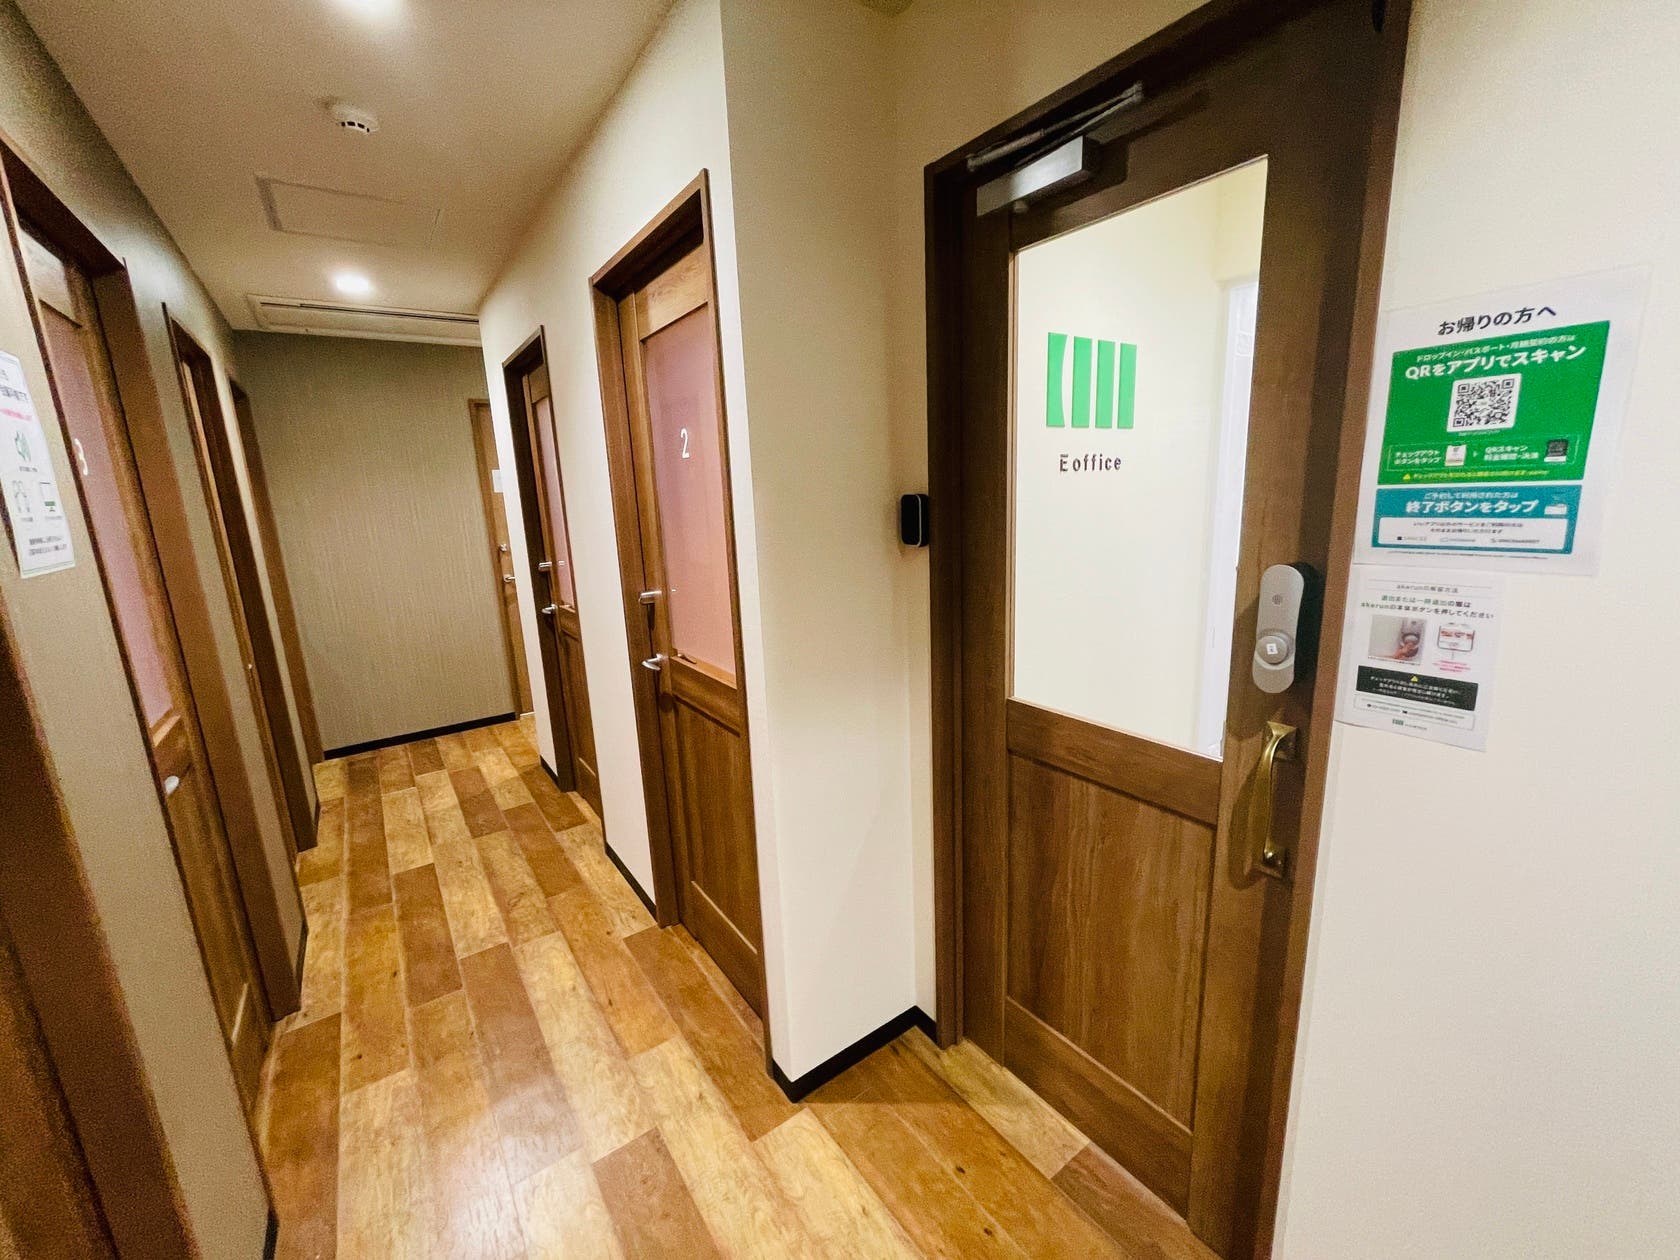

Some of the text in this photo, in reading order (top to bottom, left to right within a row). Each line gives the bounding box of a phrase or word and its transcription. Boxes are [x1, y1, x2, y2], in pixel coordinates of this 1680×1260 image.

[1437, 306, 1557, 335] お帰りの方へ
[1405, 345, 1586, 380] QRをアプリでスキャン
[74, 438, 89, 476] 3
[680, 427, 690, 459] 2
[1406, 499, 1540, 514] 終了ボタンをタップ
